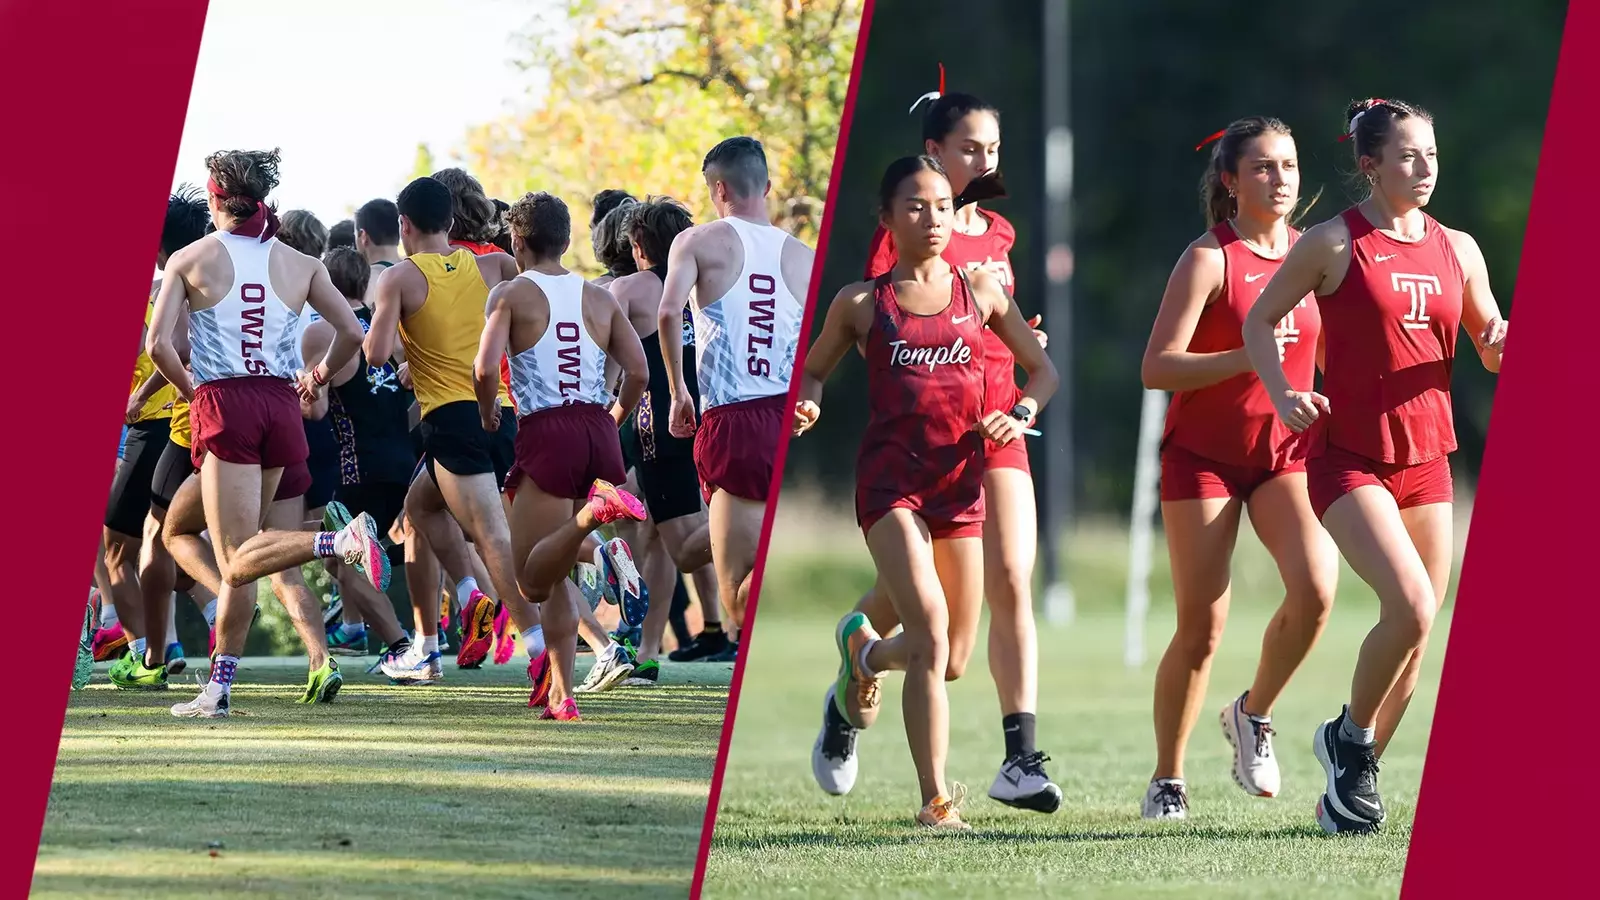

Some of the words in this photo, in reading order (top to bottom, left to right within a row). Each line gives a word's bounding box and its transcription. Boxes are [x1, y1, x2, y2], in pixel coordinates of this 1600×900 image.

[241, 283, 269, 375] OWLS
[748, 273, 775, 377] OWLS
[1391, 272, 1442, 329] T
[556, 321, 585, 406] OWL
[889, 337, 971, 372] Temple
